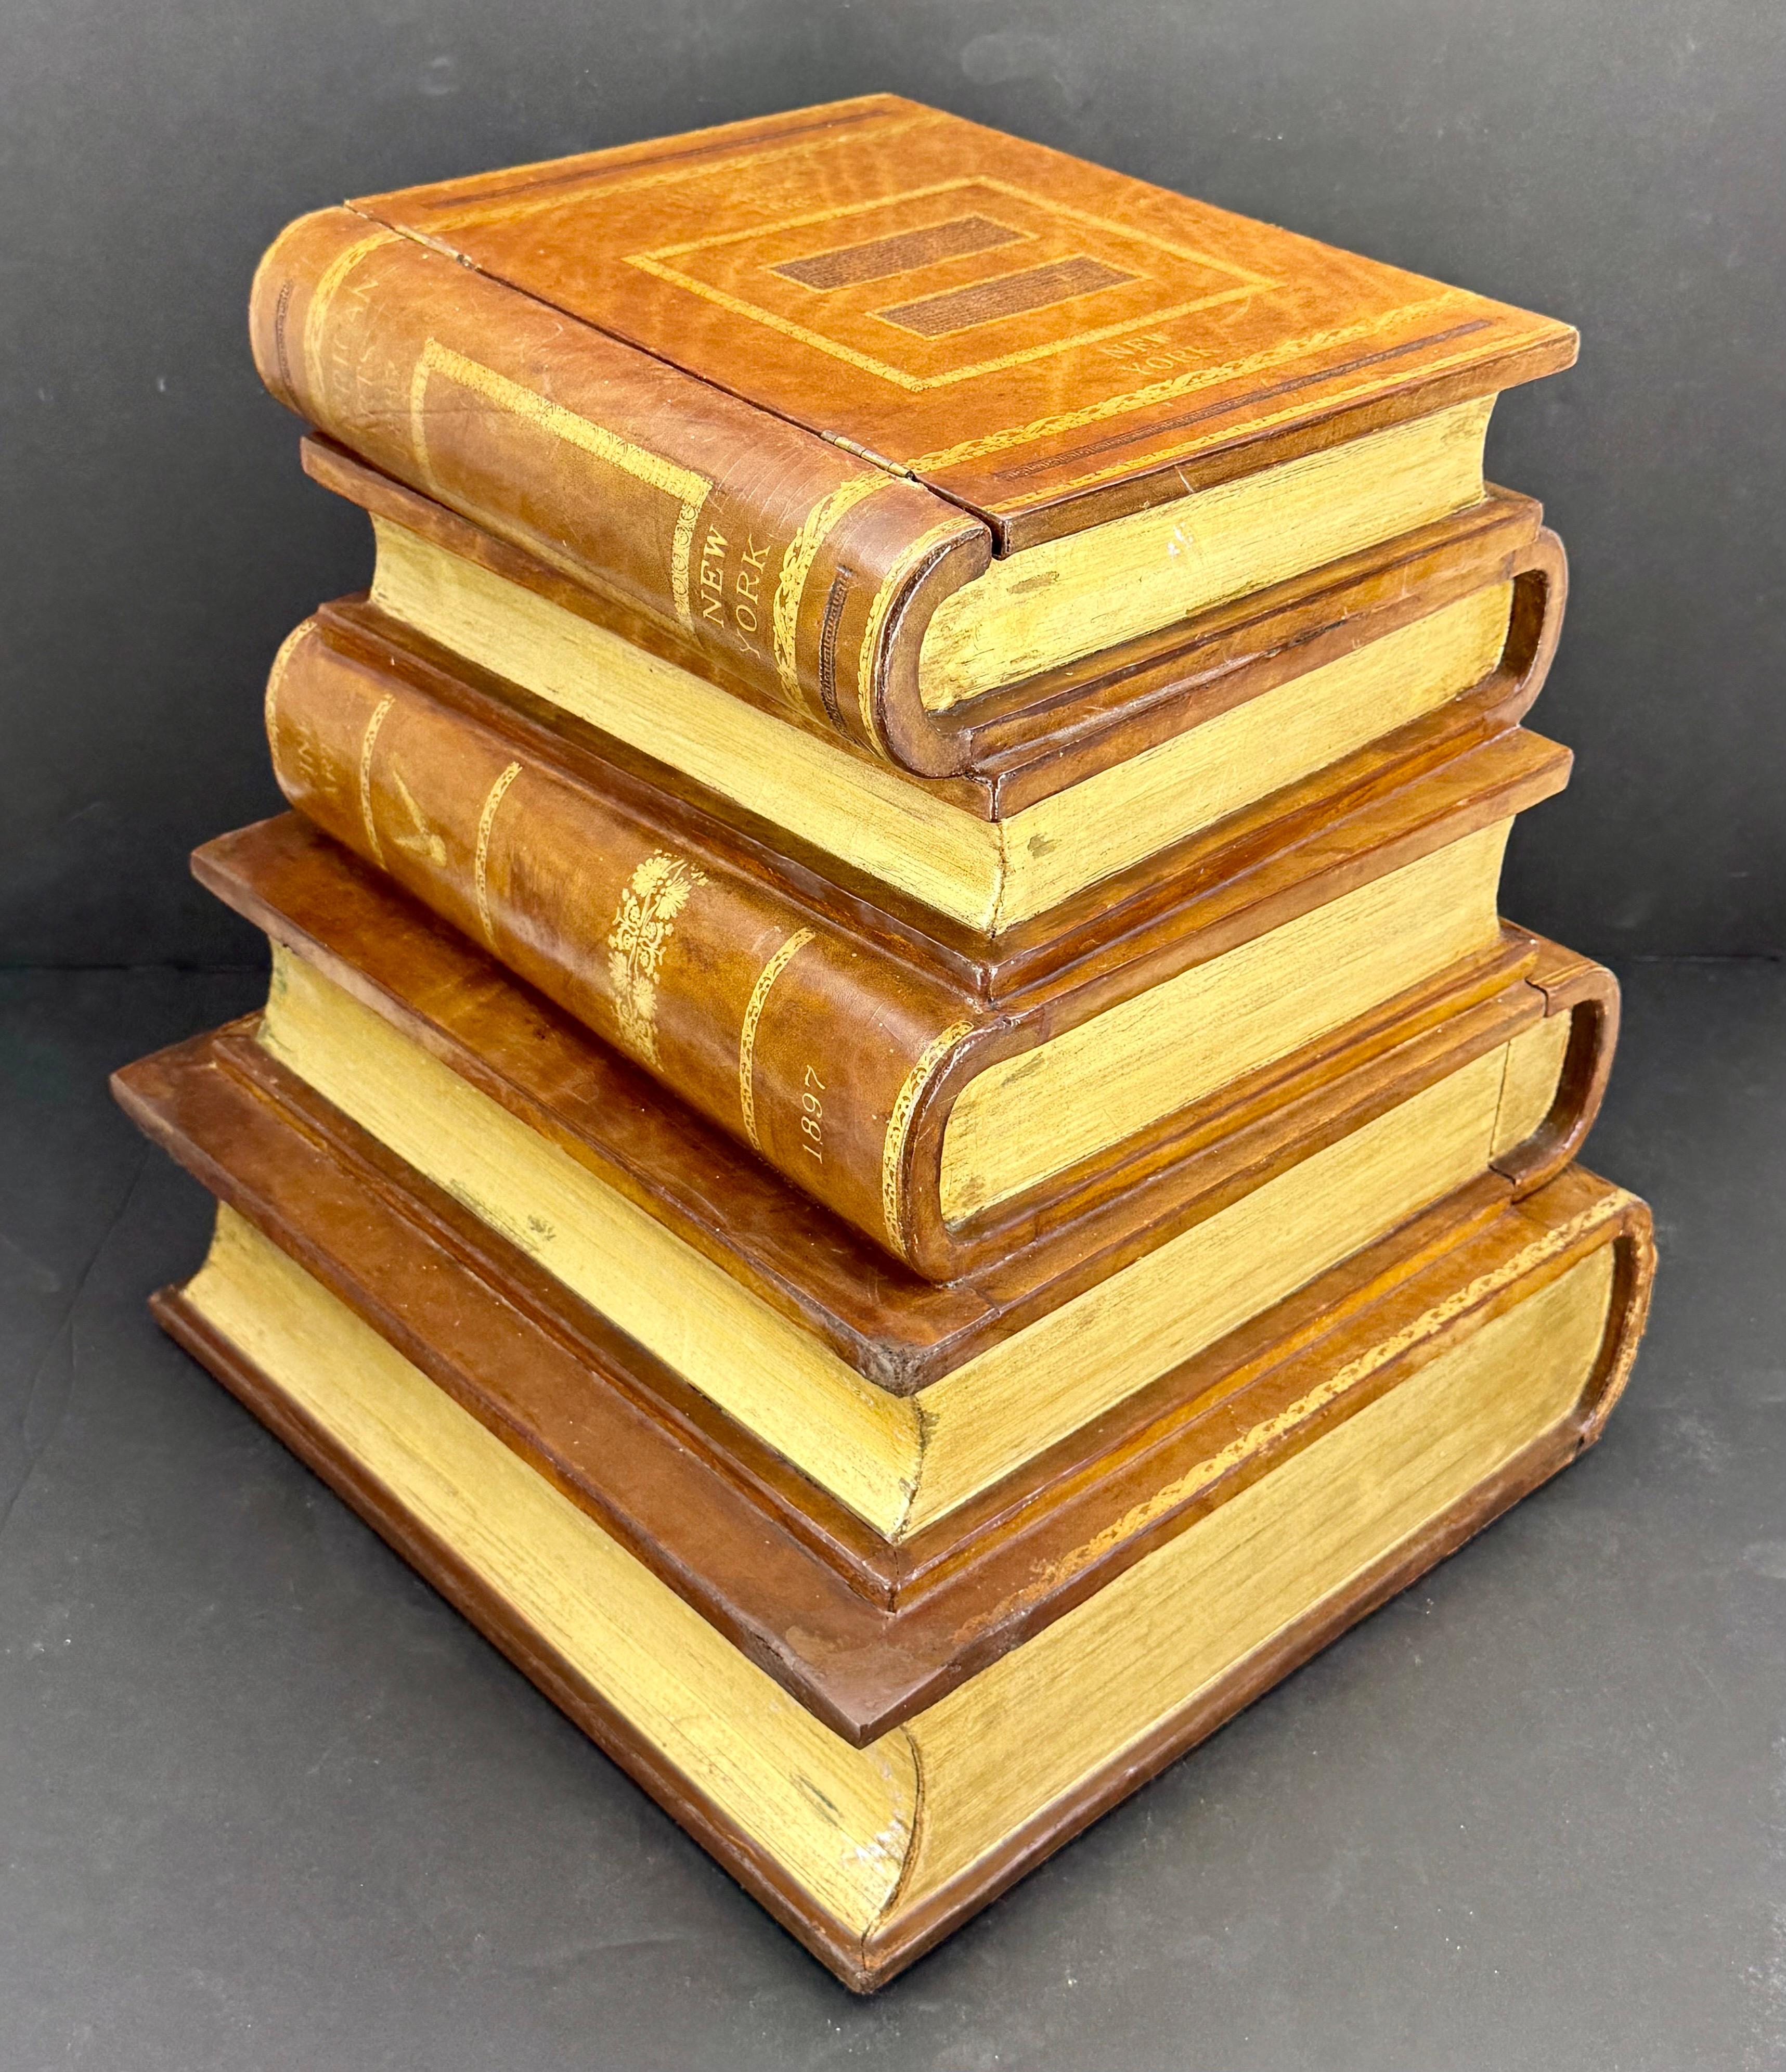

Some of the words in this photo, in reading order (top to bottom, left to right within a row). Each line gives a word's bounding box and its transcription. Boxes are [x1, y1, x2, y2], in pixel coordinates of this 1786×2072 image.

[1099, 333, 1173, 359] NEW
[1117, 345, 1224, 375] YORK
[700, 523, 729, 629] NEW
[734, 533, 772, 659] YORK
[801, 1065, 826, 1165] 1897
